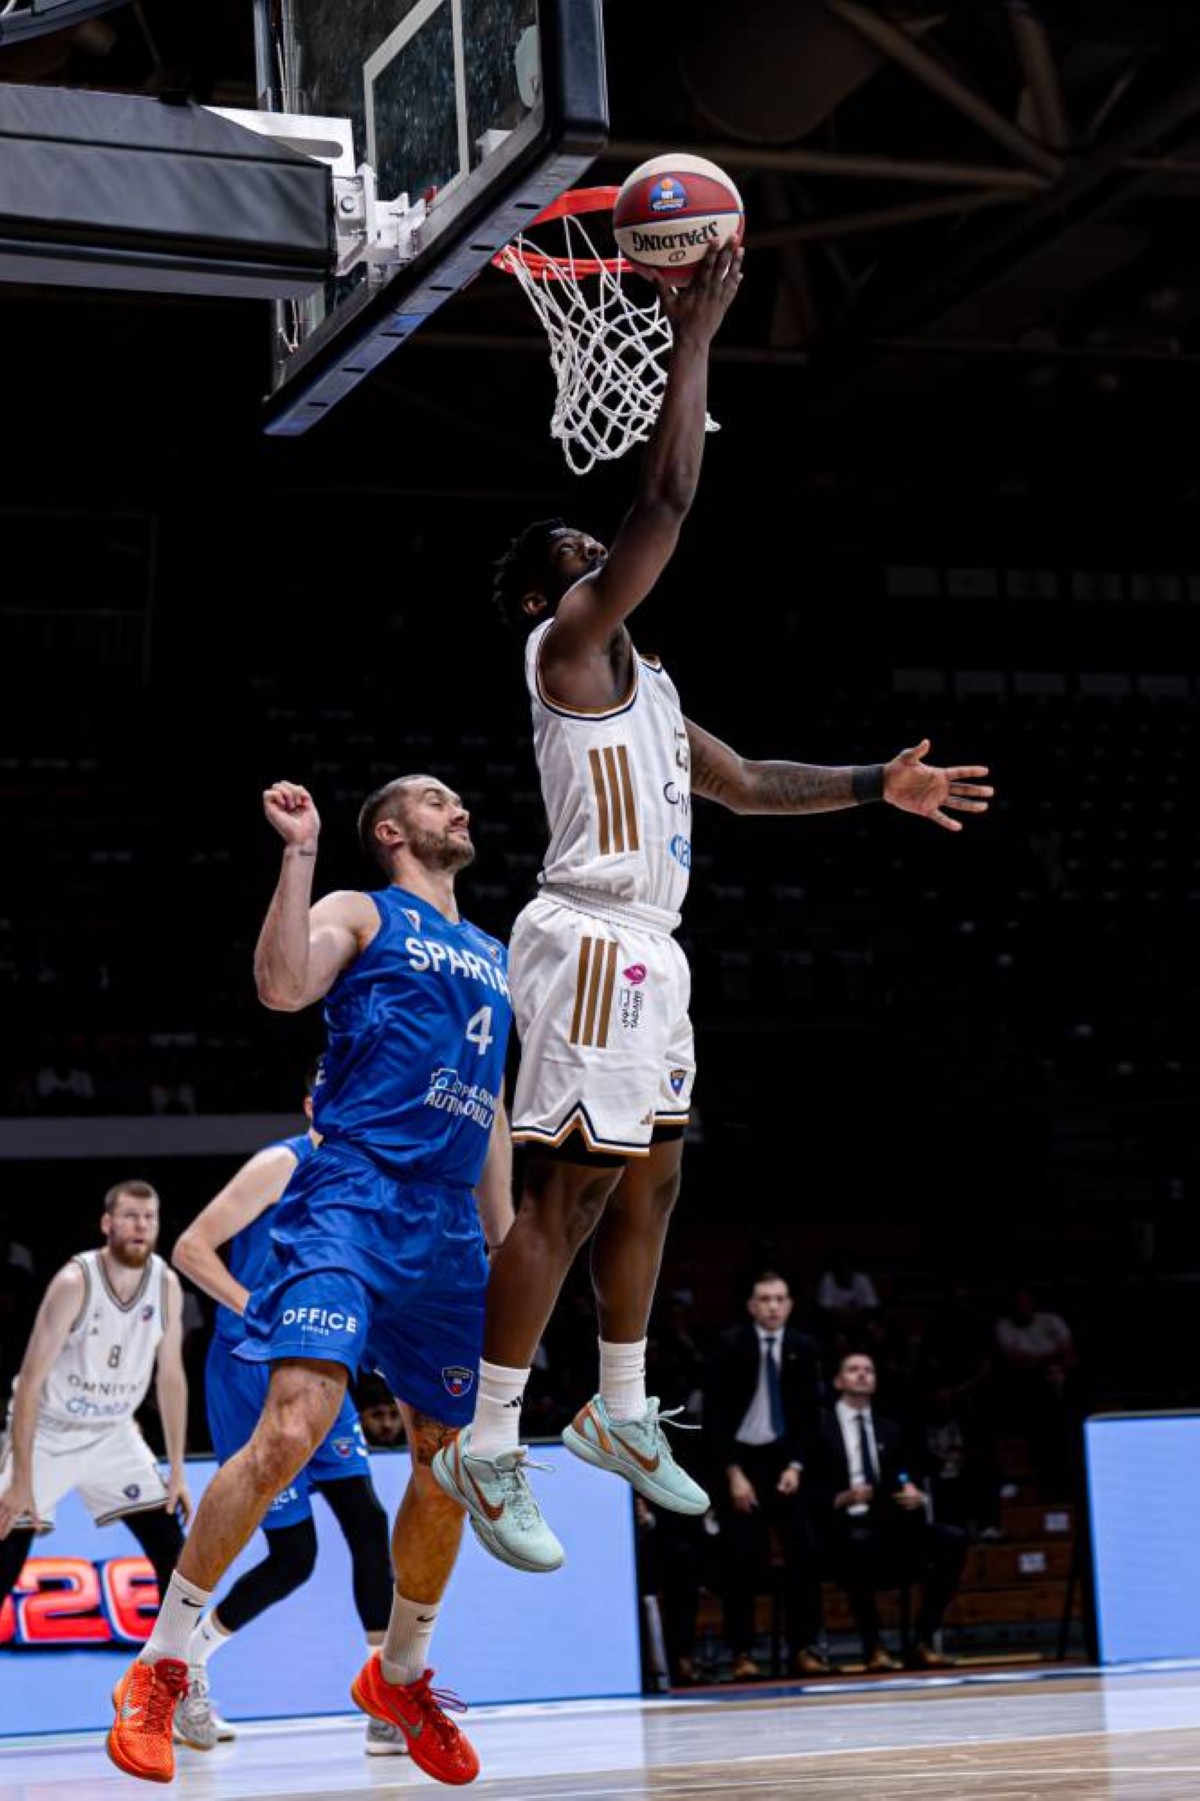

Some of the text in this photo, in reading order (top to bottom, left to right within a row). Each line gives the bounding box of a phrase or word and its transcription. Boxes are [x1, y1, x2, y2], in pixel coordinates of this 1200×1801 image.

[632, 221, 719, 252] SPALDING
[466, 1007, 493, 1055] 4
[282, 1307, 357, 1334] OFFICE
[107, 1344, 122, 1368] 8
